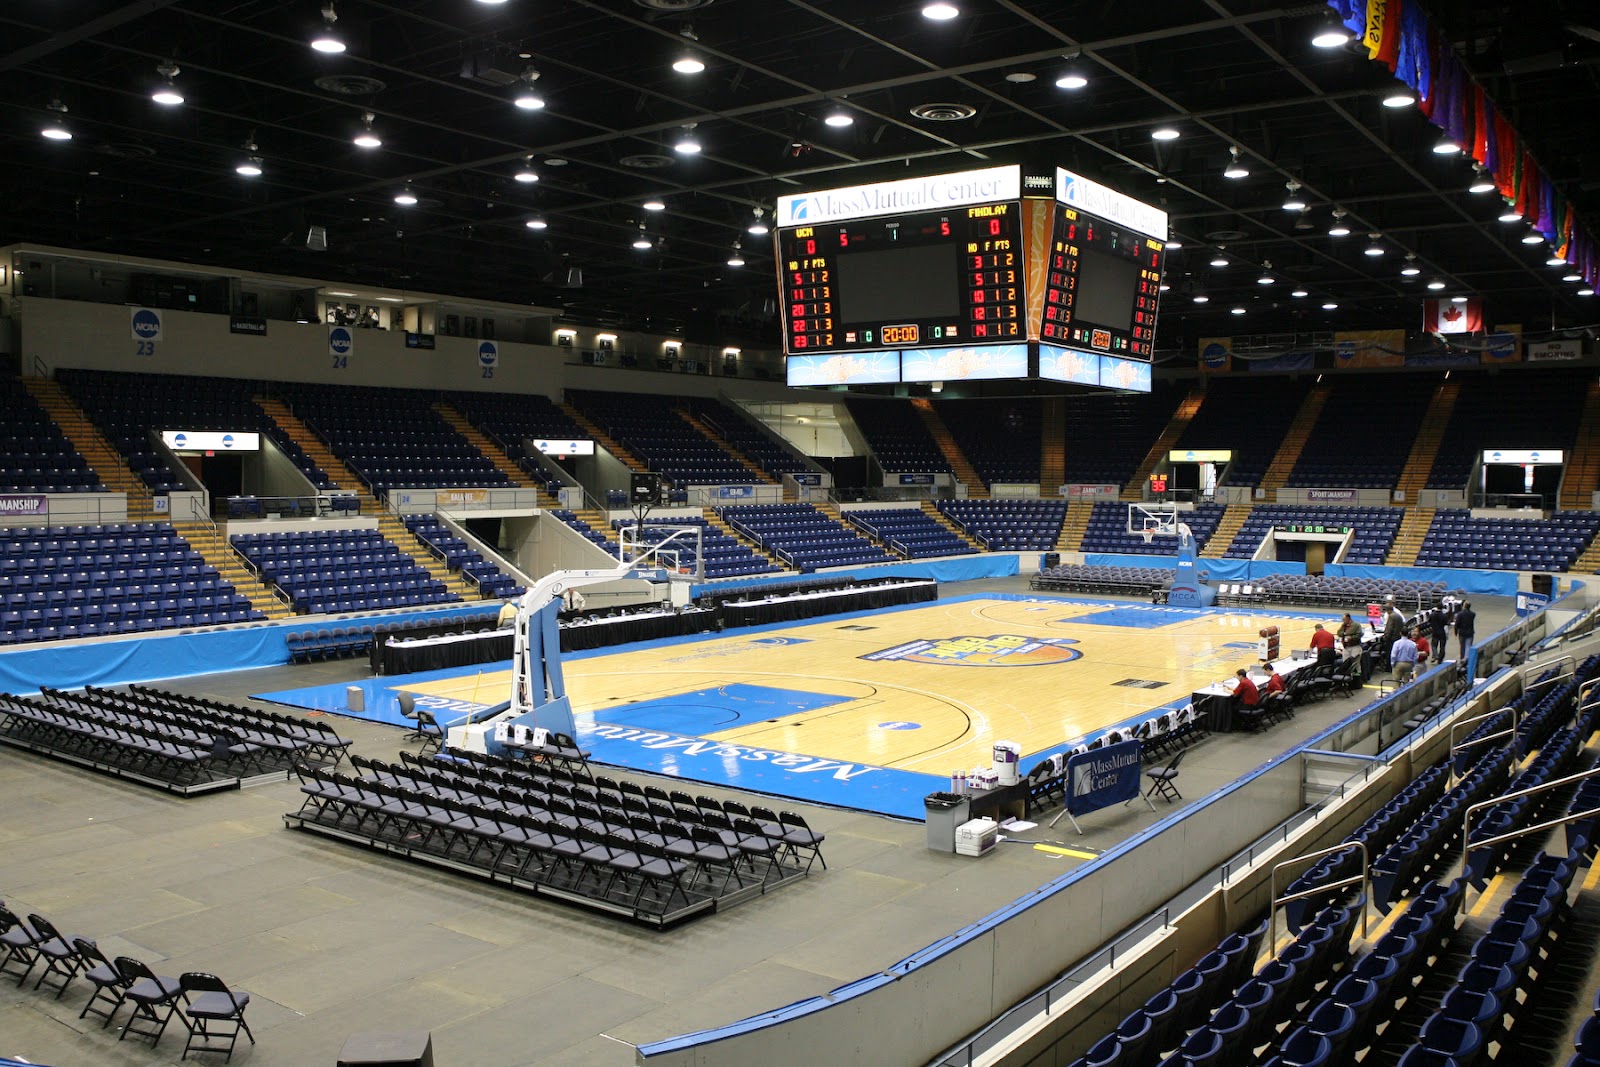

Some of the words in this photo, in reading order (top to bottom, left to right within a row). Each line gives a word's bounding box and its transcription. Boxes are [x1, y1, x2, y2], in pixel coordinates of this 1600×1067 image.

[813, 186, 928, 217] MassMutual
[931, 179, 1002, 203] Center
[968, 205, 1007, 218] FINDLAY
[796, 228, 813, 238] UCM
[941, 222, 950, 236] 5
[989, 219, 1001, 236] 0
[840, 234, 848, 247] 5
[1087, 229, 1093, 241] 5
[806, 240, 816, 255] 0
[968, 243, 978, 253] NO
[985, 242, 991, 251] F
[995, 240, 1010, 250] PTS
[789, 261, 798, 270] NO
[804, 260, 809, 269] F
[812, 258, 826, 268] PTS
[974, 255, 983, 268] 3
[1006, 253, 1014, 266] 2
[1072, 260, 1077, 273] 2
[794, 272, 803, 285] 5
[822, 270, 829, 282] 2
[975, 272, 984, 286] 5
[1007, 270, 1015, 283] 3
[1069, 277, 1076, 290] 3
[793, 288, 804, 300] 11
[823, 287, 830, 298] 3
[1141, 281, 1148, 293] 3
[973, 289, 985, 303] 10
[1007, 288, 1015, 300] 2
[792, 304, 805, 317] 20
[824, 302, 831, 314] 3
[975, 306, 986, 320] 12
[1009, 305, 1017, 318] 3
[136, 323, 159, 332] NCAA
[793, 319, 806, 332] 22
[825, 318, 832, 330] 3
[975, 323, 987, 337] 14
[1009, 322, 1017, 335] 2
[865, 330, 873, 342] 0
[883, 326, 918, 343] 20:00
[934, 326, 942, 338] 0
[332, 339, 350, 348] NCAA
[793, 335, 808, 348] 23
[826, 334, 833, 346] 2
[136, 341, 154, 356] 23
[332, 356, 348, 368] 24
[595, 351, 605, 363] 26
[687, 360, 697, 371] 27
[482, 367, 493, 378] 25
[1152, 480, 1165, 491] 35
[402, 495, 410, 503] 24
[451, 492, 473, 502] BALANCE
[559, 492, 566, 500] 24
[1311, 490, 1353, 499] SPORTSMANSHIP
[156, 500, 166, 509] 22
[638, 571, 657, 579] SPALDING
[1021, 598, 1215, 614] MassMutual
[1225, 611, 1342, 623] Center
[1368, 605, 1381, 616] 35
[585, 720, 884, 782] MassMutu
[1091, 748, 1138, 776] MassMutual
[1091, 773, 1119, 792] Center
